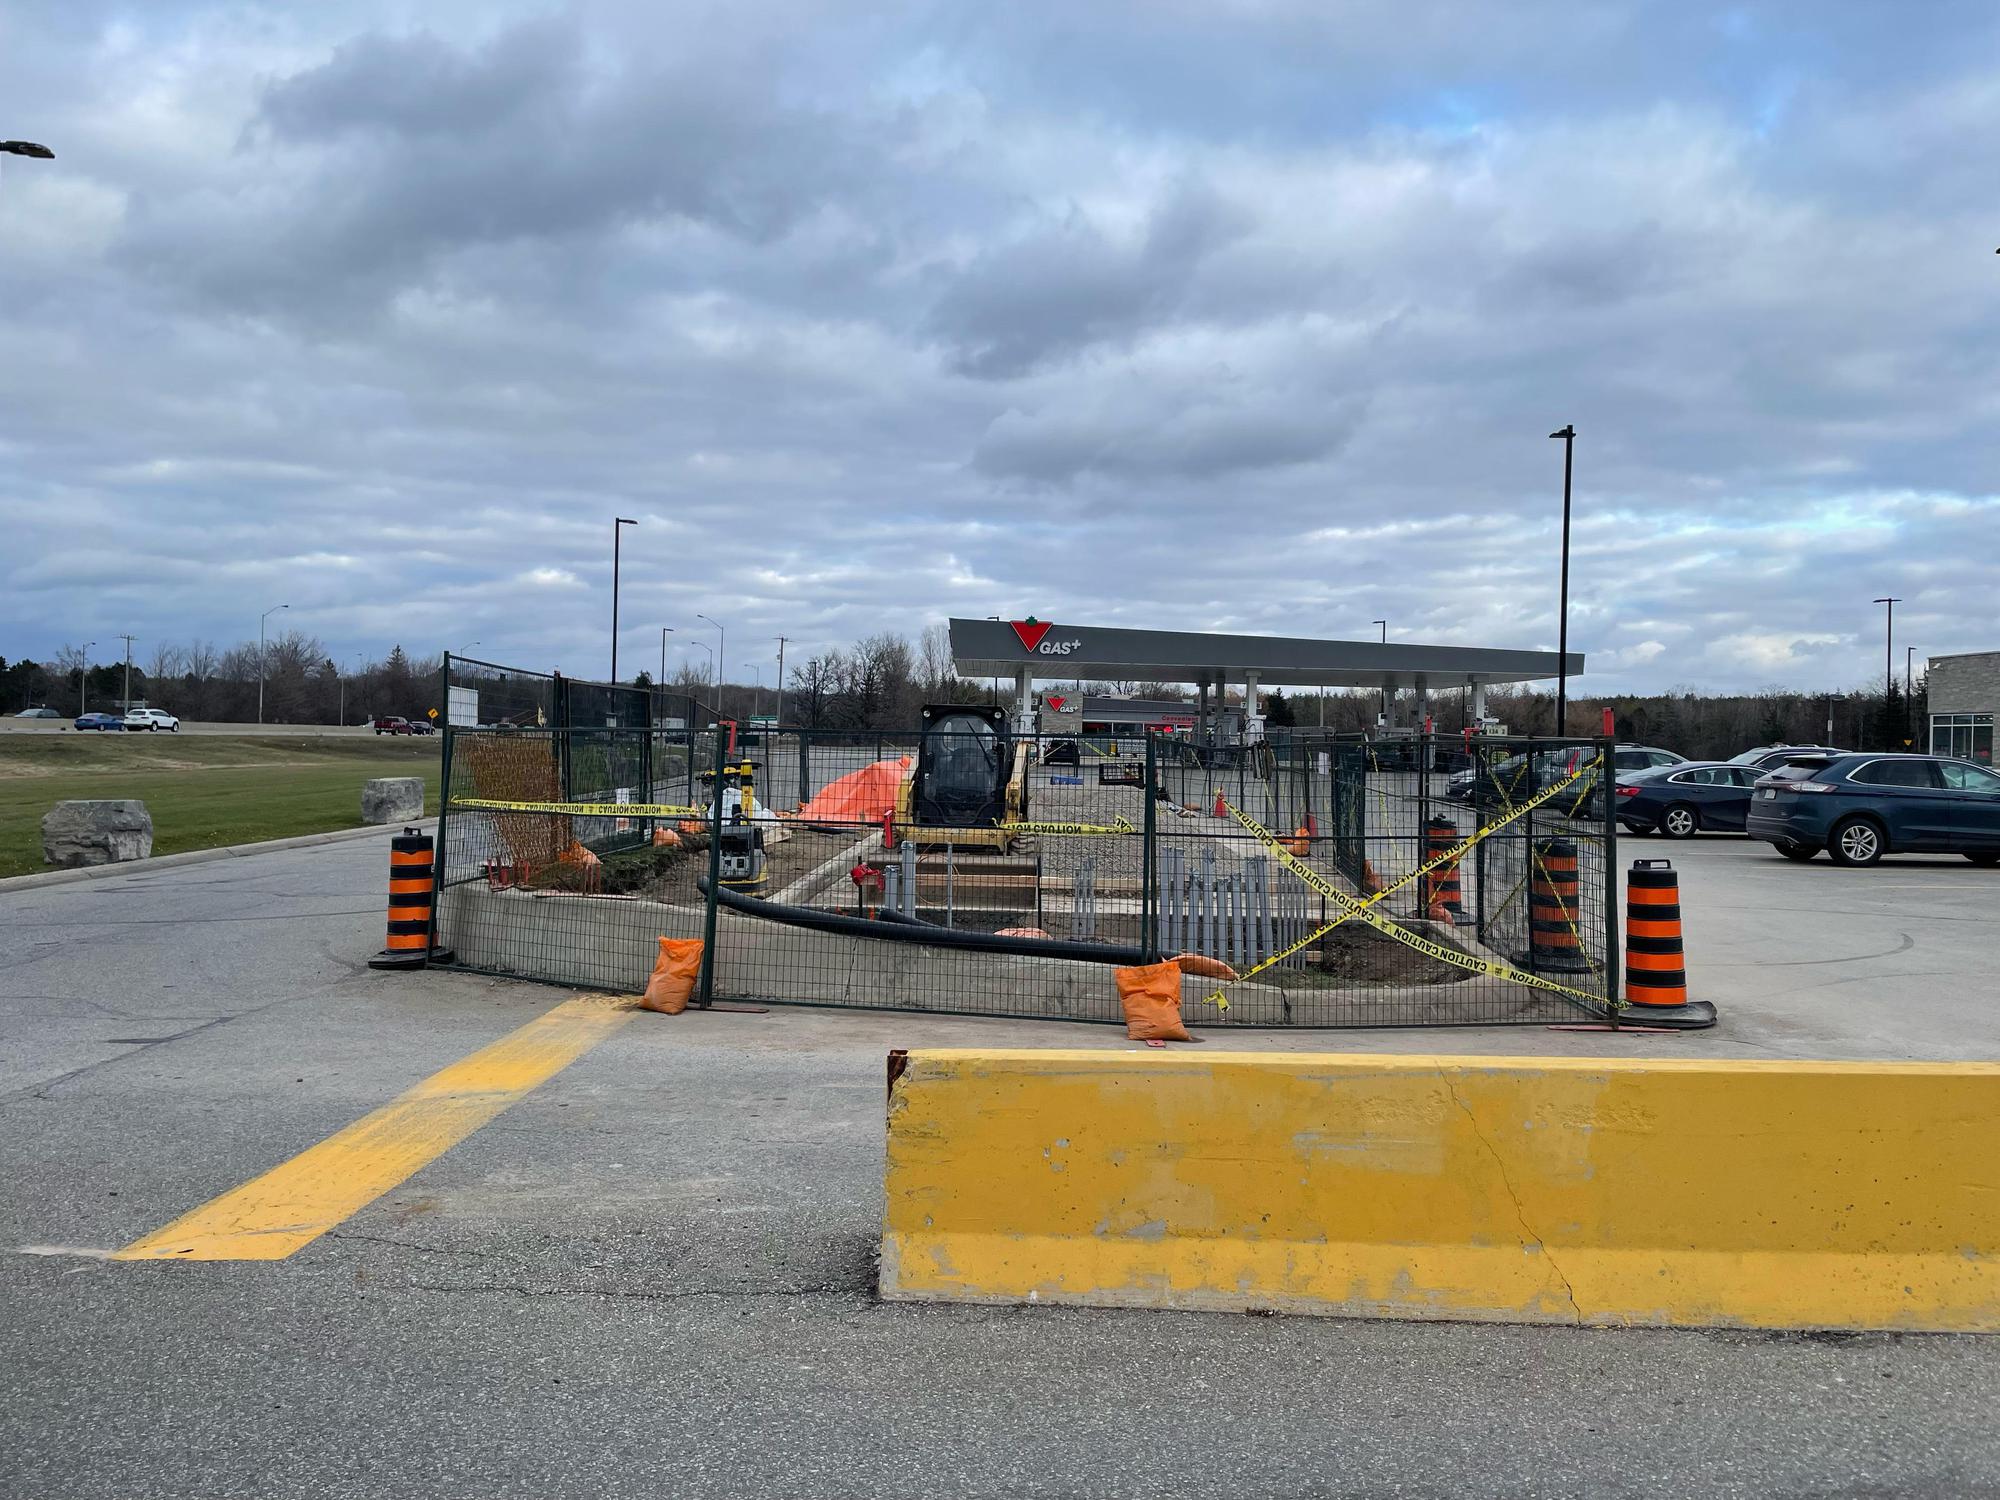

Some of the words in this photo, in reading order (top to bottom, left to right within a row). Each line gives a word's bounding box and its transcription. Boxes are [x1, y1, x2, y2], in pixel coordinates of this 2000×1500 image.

[1040, 639, 1081, 655] GAS+
[1288, 859, 1331, 894] CAUTION
[1331, 890, 1375, 922] CAUTION
[1393, 928, 1438, 956] CAUTION
[1440, 950, 1488, 972] CAUTION
